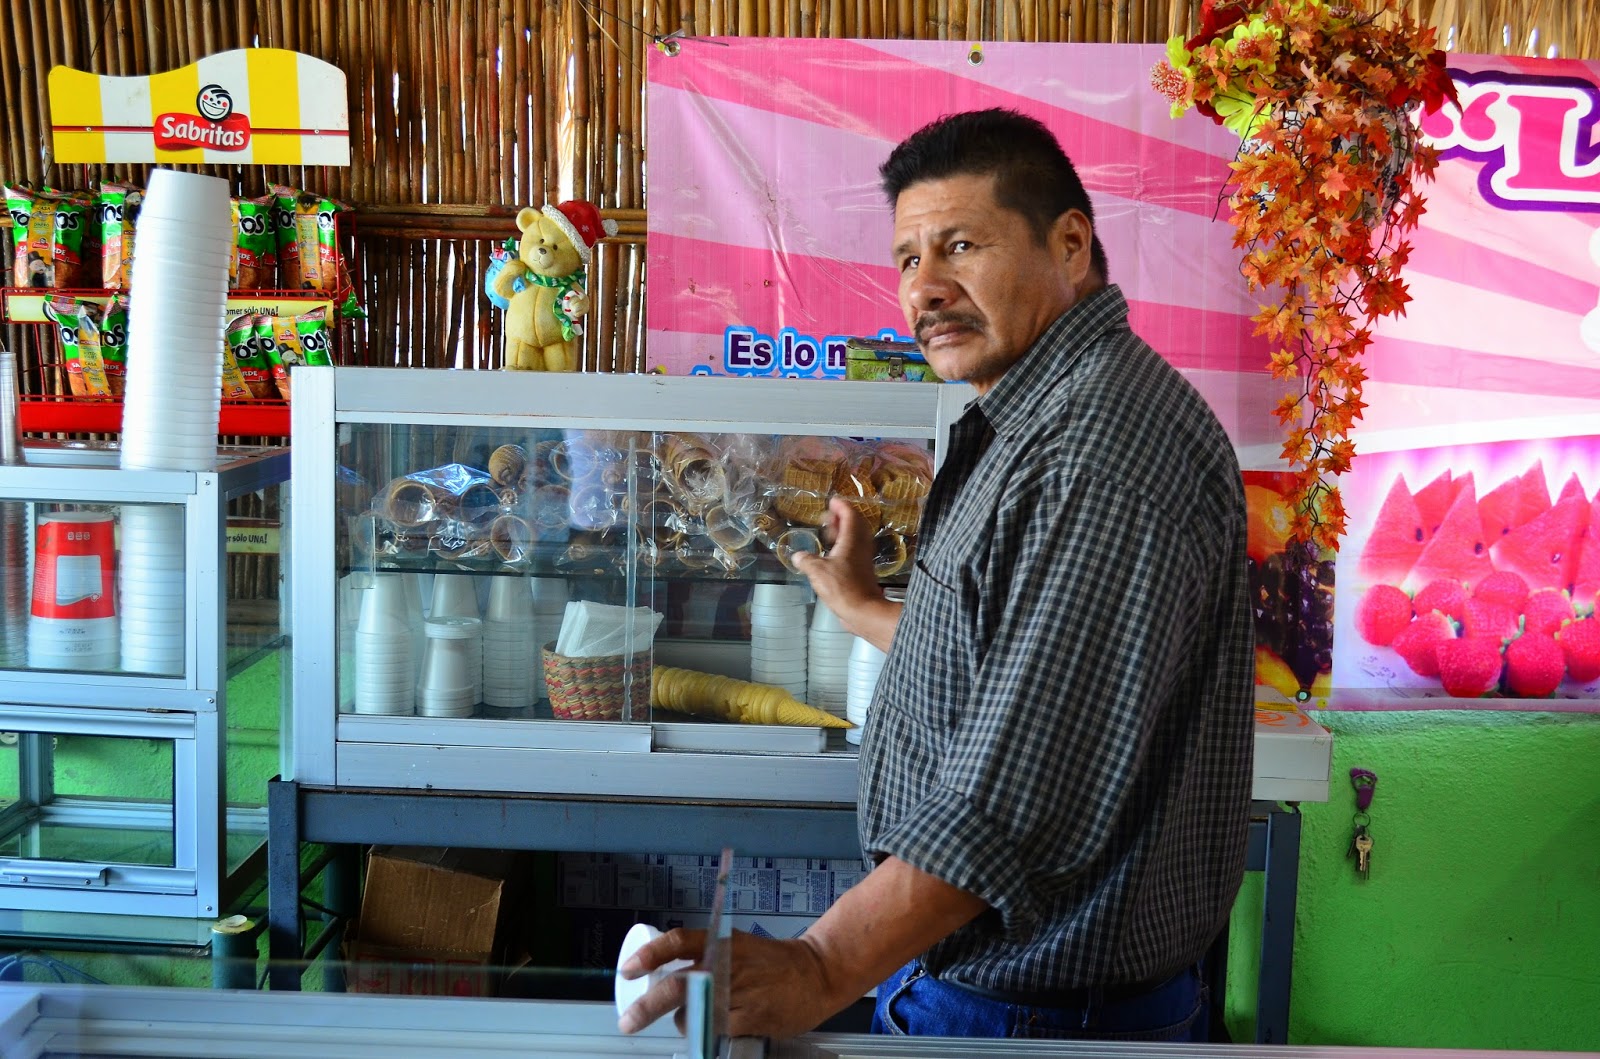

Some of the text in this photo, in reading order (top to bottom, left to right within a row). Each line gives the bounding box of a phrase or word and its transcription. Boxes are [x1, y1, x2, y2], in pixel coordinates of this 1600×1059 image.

[161, 116, 245, 146] Sabritas
[226, 308, 243, 316] omer
[260, 305, 279, 316] UNA!
[729, 333, 772, 367] Es
[783, 335, 816, 367] lo
[232, 533, 248, 542] sólo
[248, 533, 268, 544] UNA!
